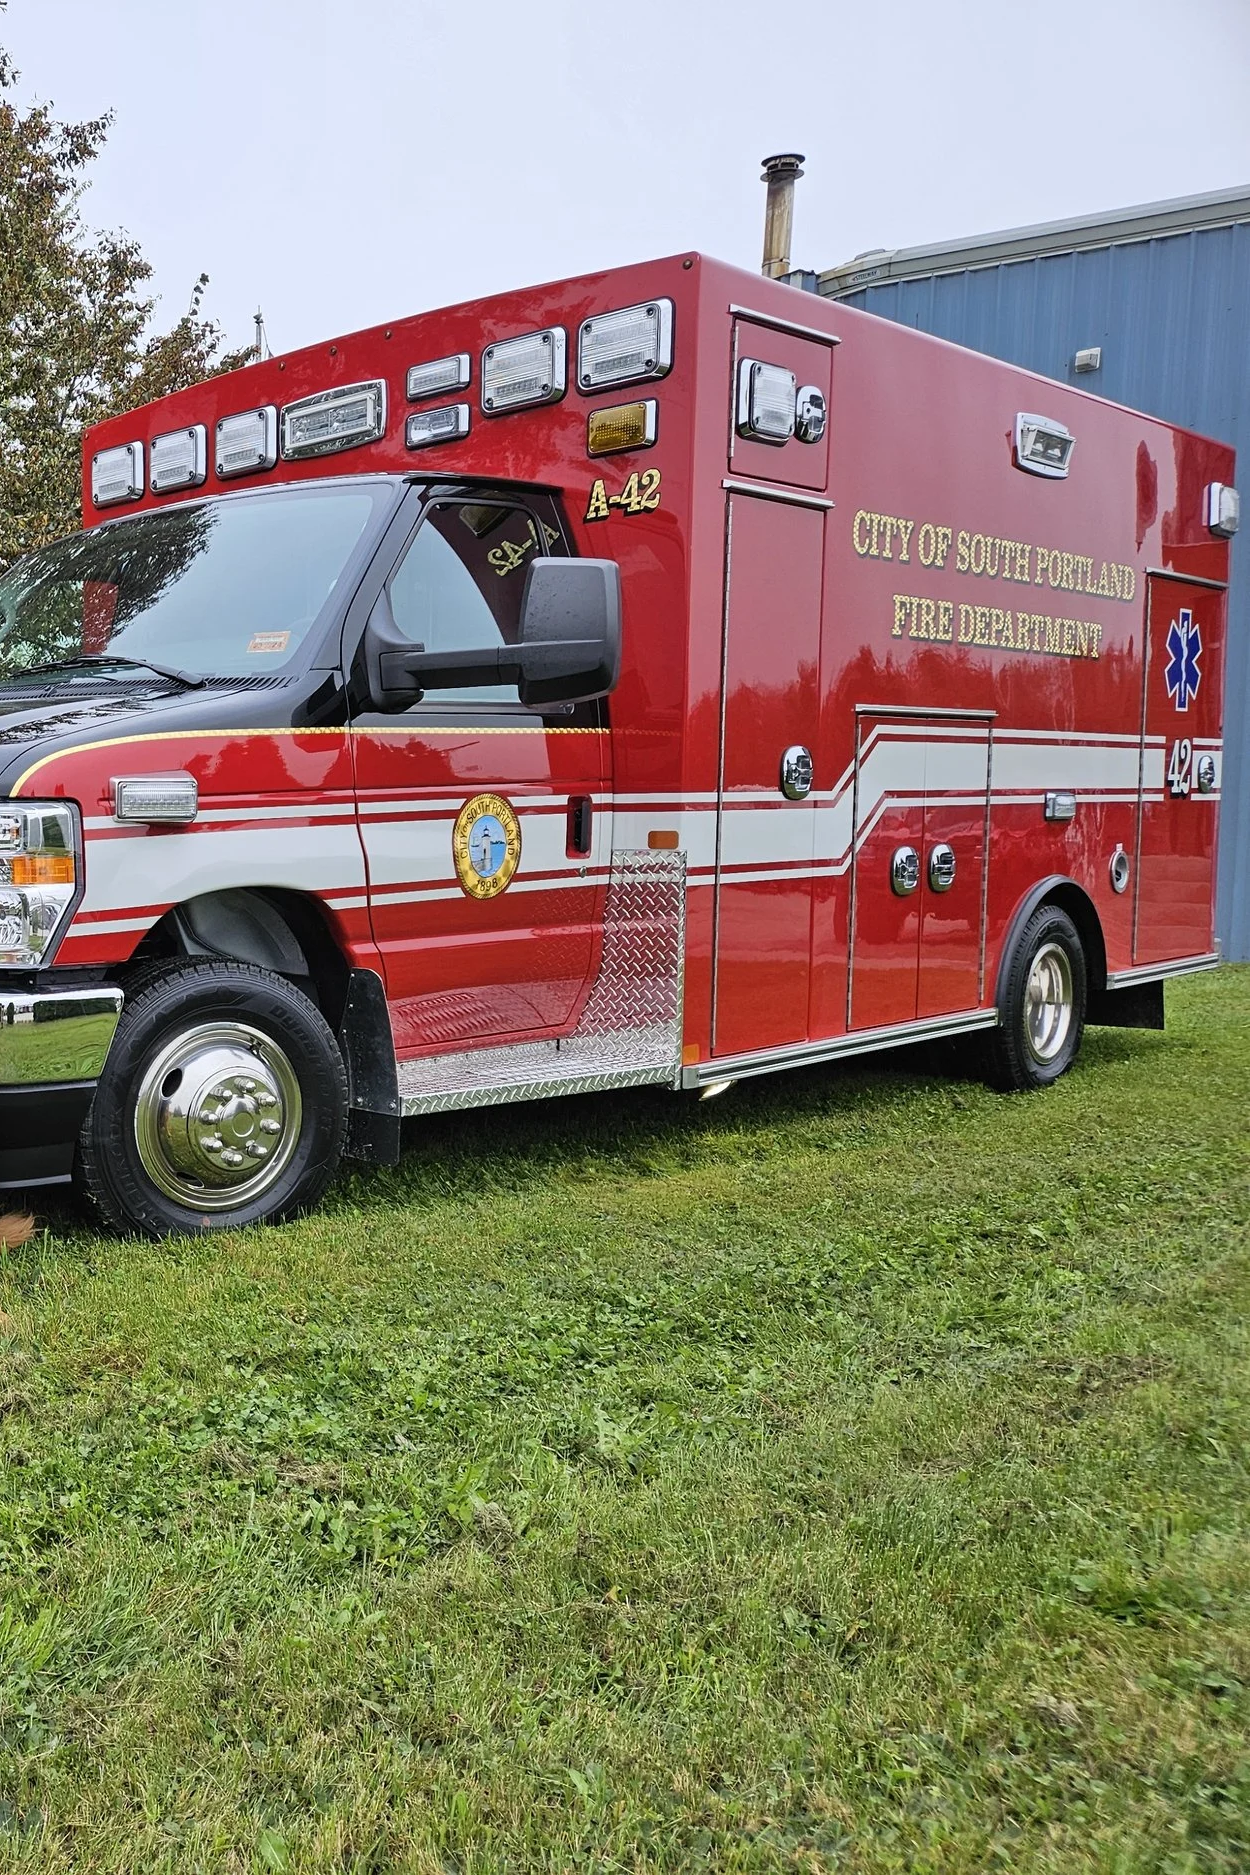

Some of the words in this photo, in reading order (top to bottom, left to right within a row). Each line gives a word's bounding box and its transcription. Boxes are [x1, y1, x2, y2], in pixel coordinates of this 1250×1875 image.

[585, 468, 661, 523] A-42
[853, 510, 914, 561] CITY
[918, 523, 952, 567] OF
[956, 530, 1032, 582] SOUTH
[1035, 547, 1136, 600] PORTLAND
[892, 595, 953, 641] FIRE
[958, 604, 1102, 658] DEPARTMENT
[1167, 738, 1191, 796] 42
[460, 832, 468, 859] CITY
[466, 801, 491, 824] SOUTH
[492, 801, 515, 856] PORTLAND
[476, 877, 498, 892] 1898
